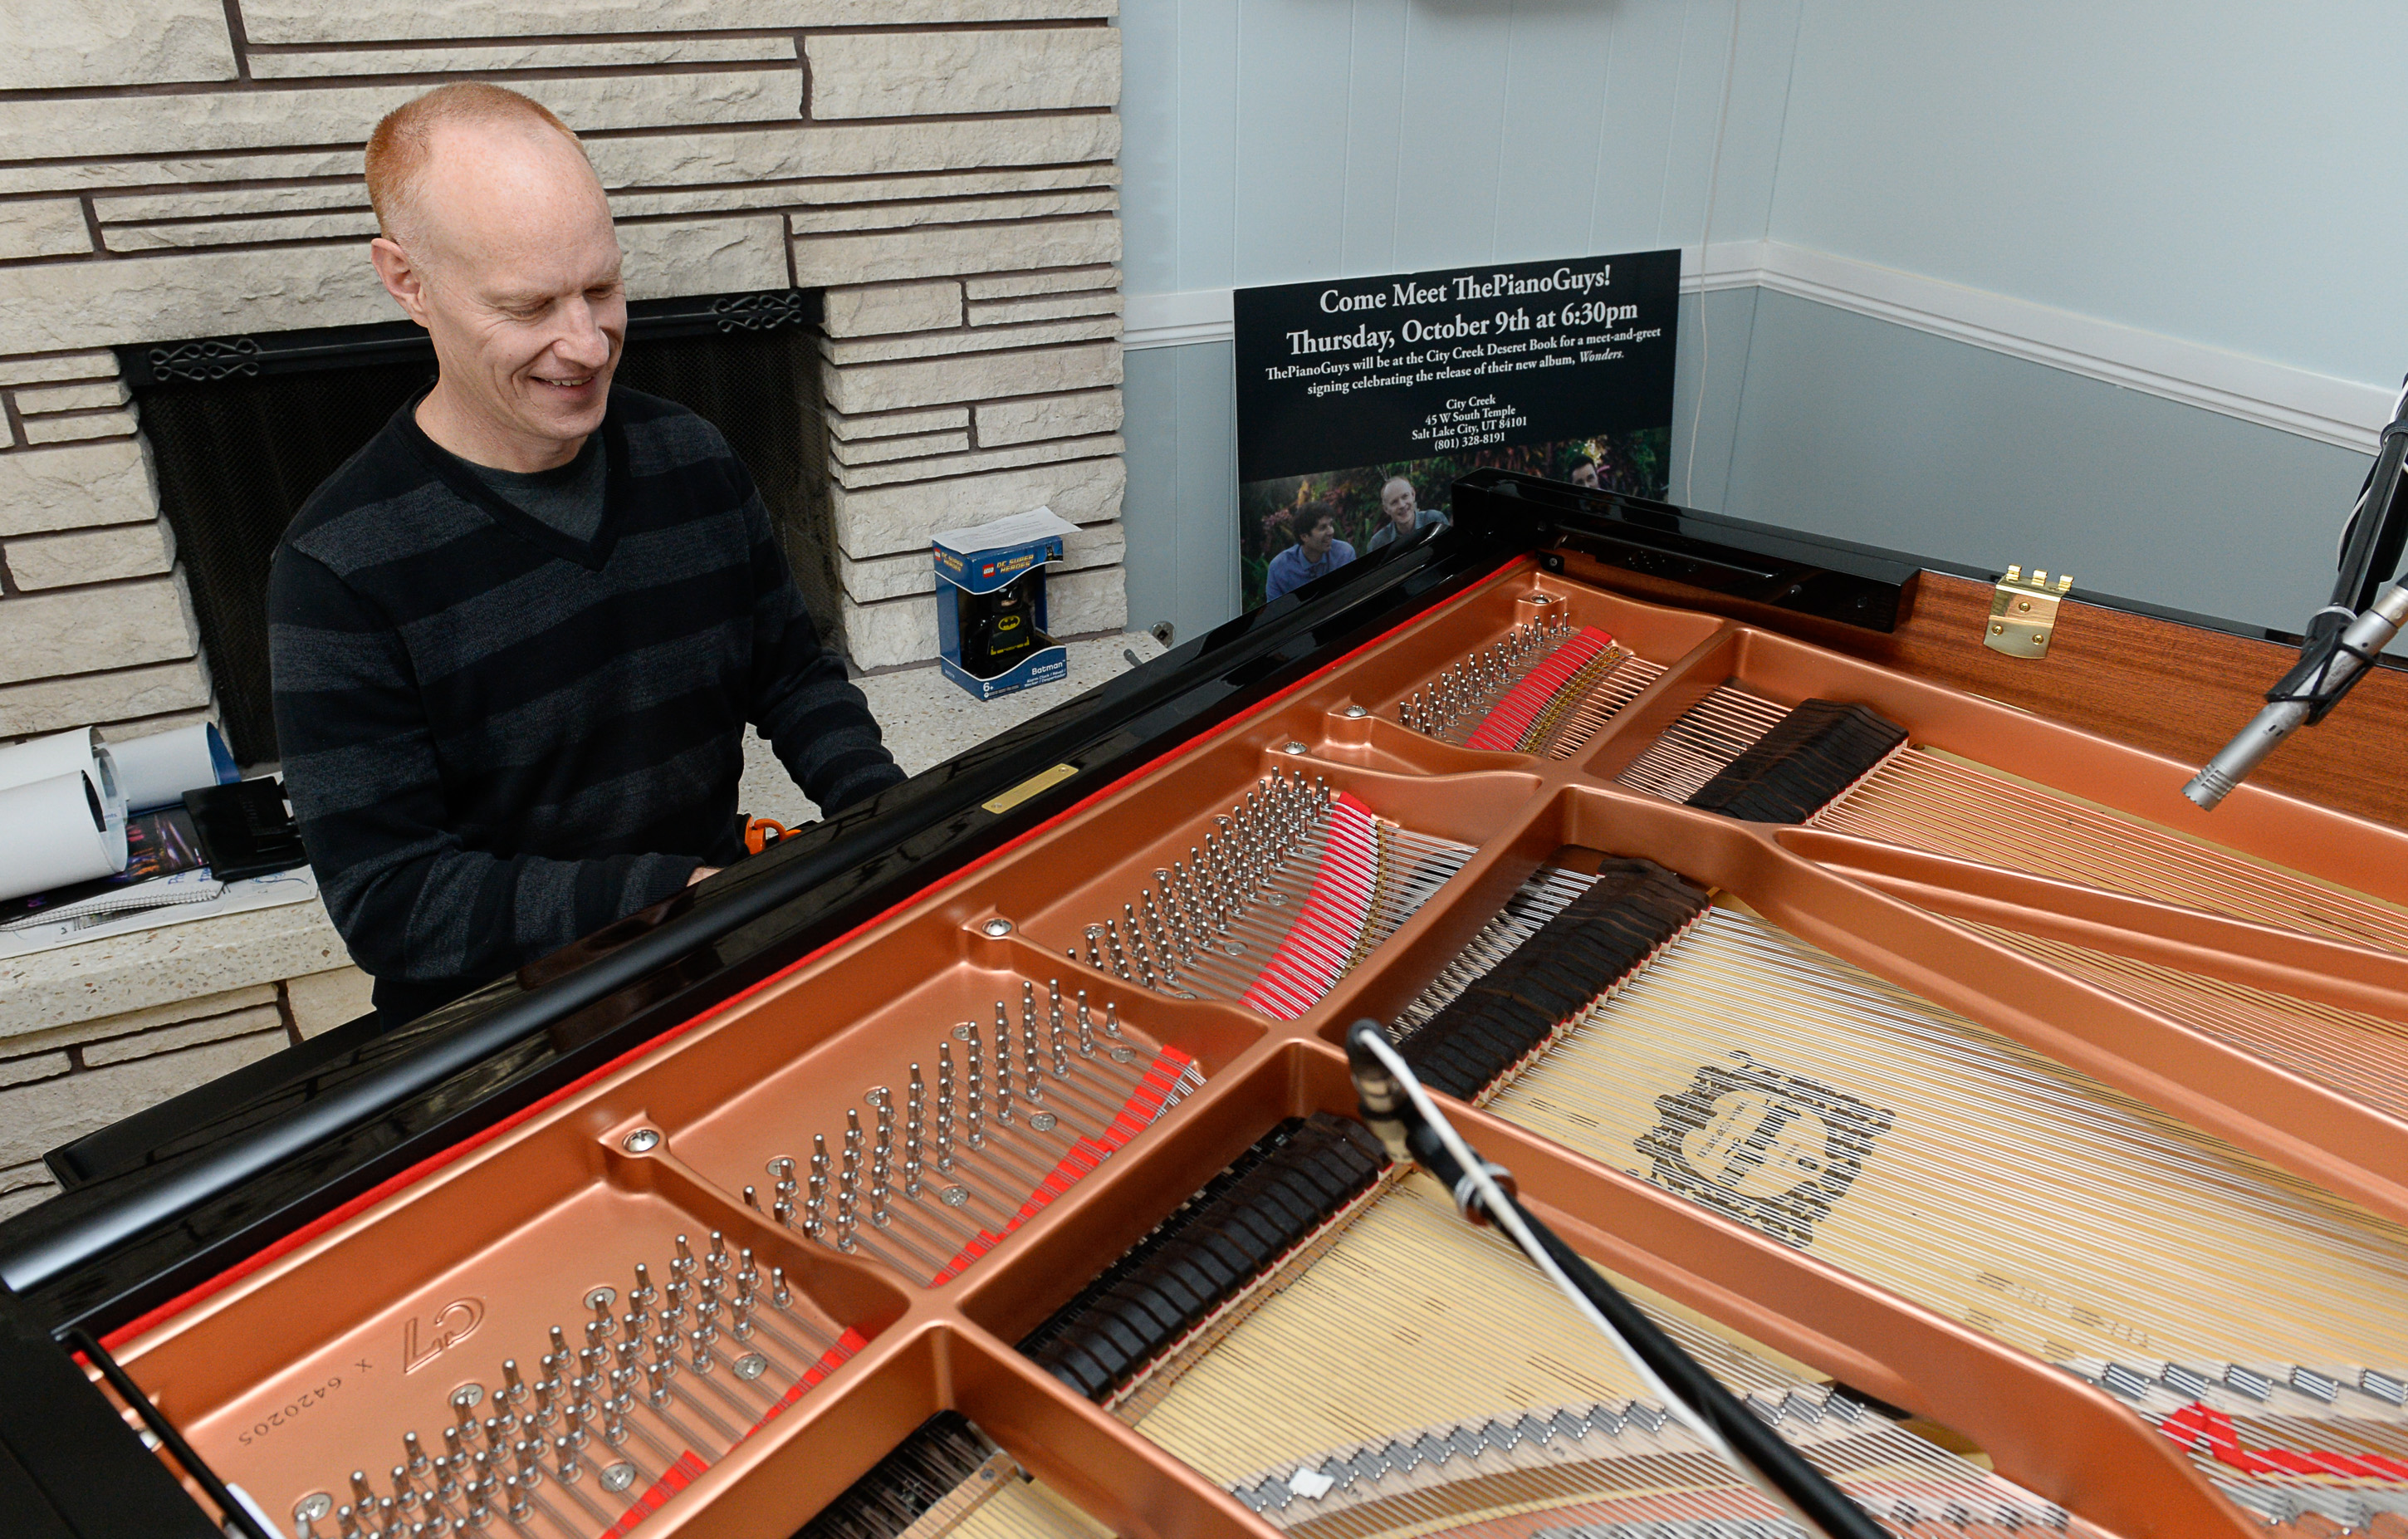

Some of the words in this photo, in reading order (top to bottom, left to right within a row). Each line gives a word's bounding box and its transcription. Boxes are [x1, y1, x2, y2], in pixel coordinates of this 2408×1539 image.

[1319, 289, 1387, 314] Come
[1392, 282, 1448, 307] Meet
[1451, 263, 1611, 301] ThePianoGuys!
[1286, 323, 1396, 355] Thursday,
[1402, 313, 1490, 343] October
[1495, 307, 1530, 335] 9th
[1535, 308, 1557, 329] at
[1561, 301, 1638, 329] 6:30pm
[1265, 361, 1350, 380] ThePianoGuys
[1352, 356, 1374, 370] will
[1376, 355, 1391, 368] be
[1392, 355, 1404, 366] at
[1406, 351, 1424, 365] the
[1426, 350, 1450, 365] City
[1452, 345, 1485, 360] Creek
[1487, 341, 1526, 356] Deseret
[1529, 336, 1558, 351] Book
[1559, 335, 1575, 348] for
[1577, 336, 1584, 346] a
[1586, 327, 1662, 345] meet-and-greet
[1307, 380, 1350, 397] signing
[1352, 374, 1413, 390] celebrating
[1415, 368, 1434, 382] the
[1436, 366, 1471, 381] release
[1474, 361, 1487, 375] of
[1487, 359, 1514, 374] their
[1515, 360, 1537, 371] new
[1539, 354, 1576, 368] album,
[1579, 348, 1625, 363] Wonders.
[1425, 414, 1437, 425] 45
[1439, 412, 1451, 424] W
[1452, 409, 1481, 422] South
[1481, 404, 1516, 419] Temple
[1446, 399, 1466, 411] City
[1468, 394, 1496, 407] Creek
[1412, 428, 1430, 440] Salt
[1432, 425, 1456, 438] Lake
[1457, 424, 1479, 435] City,
[1481, 419, 1497, 431] UT
[1499, 416, 1527, 429] 84101
[1434, 438, 1460, 451] (801)
[1461, 432, 1505, 447] 328-8191
[996, 561, 1007, 569] DC
[1009, 554, 1035, 565] SUPER
[1000, 561, 1031, 573] HEROES
[982, 682, 994, 692] 6+
[404, 1296, 485, 1376] C7
[238, 1376, 343, 1446] 6420205
